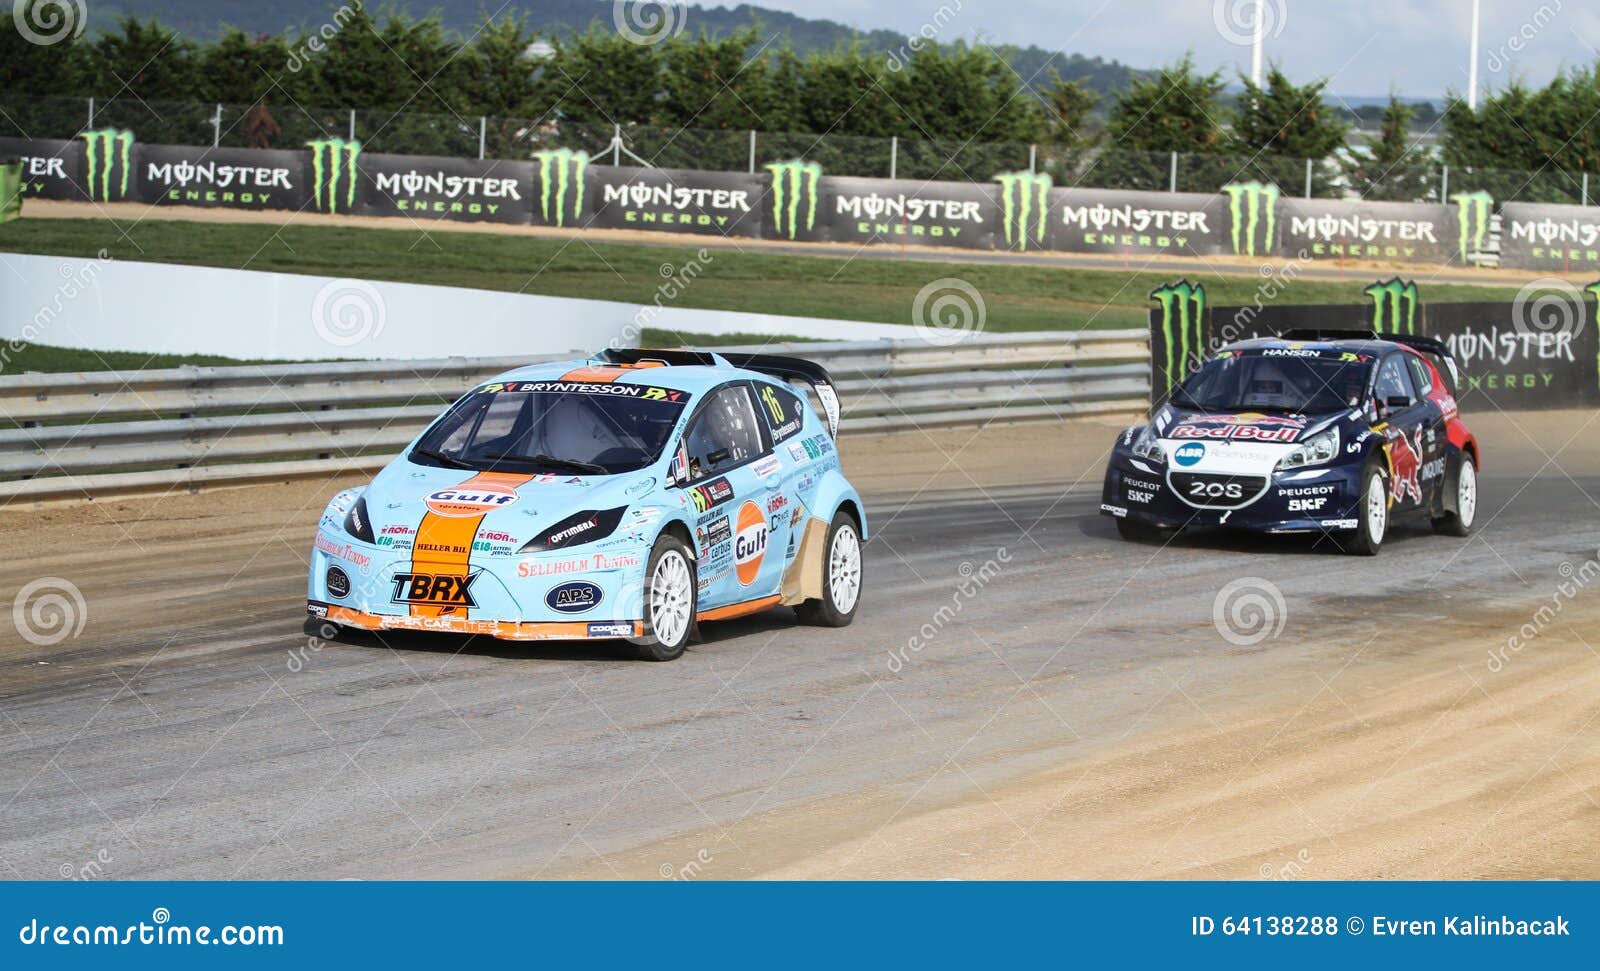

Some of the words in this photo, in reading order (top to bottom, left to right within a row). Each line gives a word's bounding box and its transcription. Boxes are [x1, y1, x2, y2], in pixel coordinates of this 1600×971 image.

[148, 160, 293, 189] MONSTER
[376, 170, 522, 201] MONSTER
[169, 190, 271, 203] ENERGY
[603, 181, 751, 212] MONSTER
[397, 200, 500, 215] ENERGY
[836, 192, 983, 224] MONSTER
[625, 211, 728, 226] ENERGY
[1062, 203, 1210, 234] MONSTER
[858, 222, 962, 237] ENERGY
[1290, 214, 1438, 244] MONSTER
[1511, 218, 1600, 246] MONS
[1083, 233, 1189, 248] ENERGY
[1312, 242, 1415, 257] ENERGY
[1262, 349, 1321, 357] HANSEN
[520, 383, 640, 396] BRYNTESSON
[762, 386, 784, 424] 16
[1168, 425, 1231, 439] Red
[1231, 426, 1300, 442] Bull
[1123, 476, 1163, 492] PEUGEOT
[1189, 481, 1243, 498] 208
[1278, 486, 1335, 497] PEUGEOT
[430, 491, 515, 504] Gulf
[1127, 490, 1154, 504] SKF
[1288, 498, 1328, 512] SKF
[550, 520, 596, 543] OPTIMERA
[417, 543, 451, 552] HELLER
[736, 528, 766, 560] Gulf
[391, 573, 481, 603] TBRX
[556, 587, 594, 604] APS
